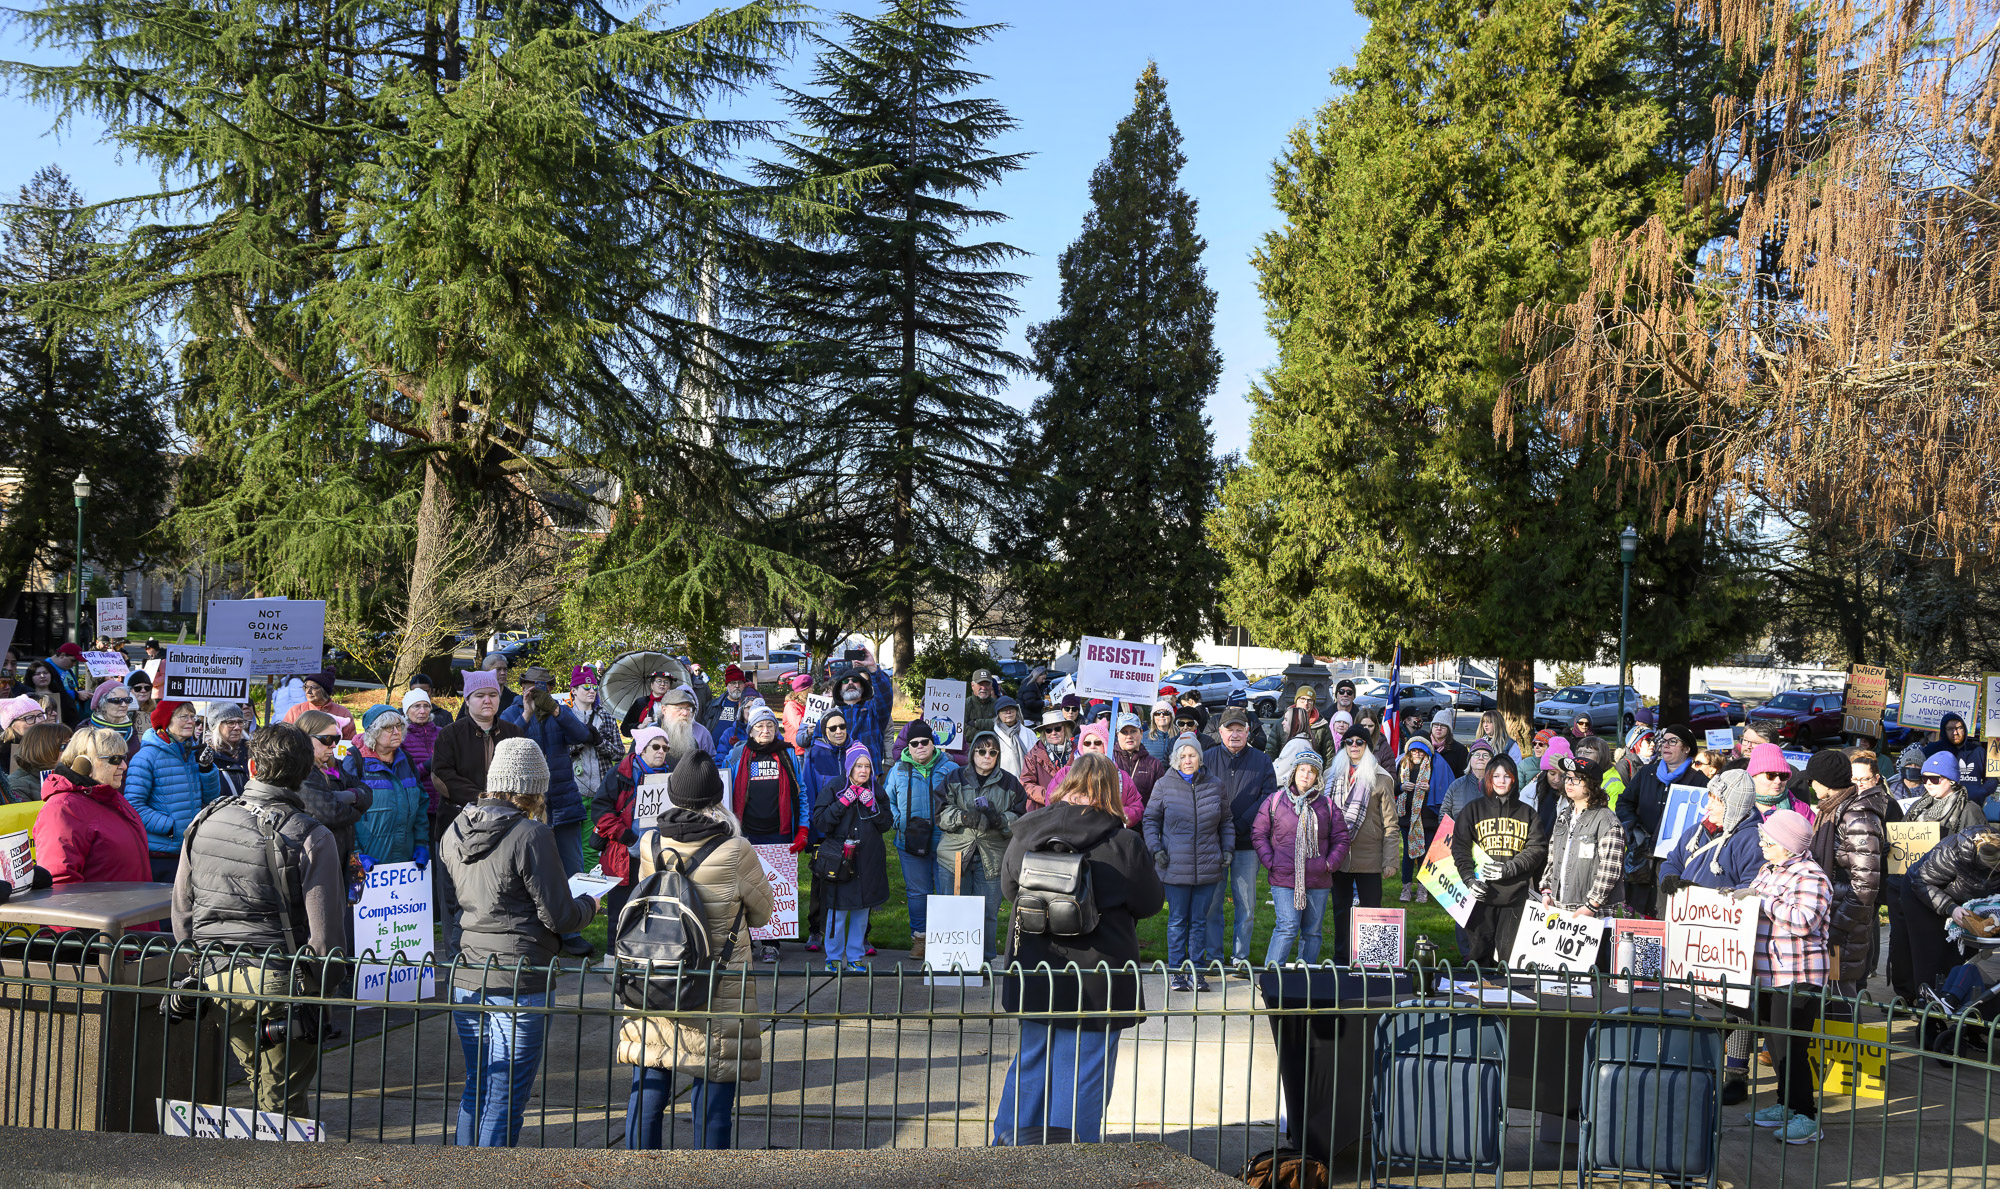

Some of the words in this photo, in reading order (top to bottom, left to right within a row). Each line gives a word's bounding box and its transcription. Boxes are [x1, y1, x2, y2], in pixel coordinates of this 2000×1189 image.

[106, 601, 123, 610] TIME
[258, 610, 281, 618] NOT
[248, 621, 288, 631] GOING
[254, 632, 283, 640] BACK
[169, 651, 209, 666] Embracing
[210, 653, 244, 667] diversity
[185, 665, 190, 673] is
[191, 666, 201, 674] not
[202, 666, 227, 674] socialism
[1109, 669, 1124, 679] THE
[1125, 671, 1154, 682] SEQUEL
[1856, 665, 1884, 676] WHEN
[171, 681, 177, 690] it
[177, 681, 182, 690] is
[184, 678, 243, 697] HUMANITY
[927, 686, 951, 698] There
[1922, 681, 1956, 693] STOP
[808, 697, 830, 711] YOU
[931, 702, 949, 711] NO
[1910, 693, 1971, 710] SCAPEGOATING
[956, 722, 963, 733] B
[1845, 715, 1878, 736] DUTY
[1960, 774, 1978, 782] didas
[641, 788, 665, 804] MY
[638, 802, 662, 817] BODY
[1475, 818, 1496, 840] THE
[1891, 825, 1907, 841] You
[1907, 826, 1932, 841] Can't
[11, 847, 21, 858] NO
[13, 859, 22, 869] NO
[15, 870, 24, 880] NO
[364, 868, 426, 889] RESPECT
[1424, 859, 1438, 876] MY
[1438, 873, 1468, 909] CHOICE
[390, 890, 399, 899] &
[358, 898, 427, 921] Compassion
[1671, 886, 1743, 925] Women's
[1529, 905, 1546, 922] The
[377, 922, 389, 935] is
[393, 921, 418, 934] how
[771, 921, 798, 937] SHIT
[375, 939, 382, 953] I
[390, 935, 422, 951] show
[927, 928, 981, 946] DISSENT
[1532, 930, 1545, 946] Can
[1555, 934, 1586, 957] NOT
[1584, 934, 1599, 947] man
[1685, 928, 1747, 970] Health
[942, 951, 970, 967] WE
[1809, 1055, 1886, 1091] FEA
